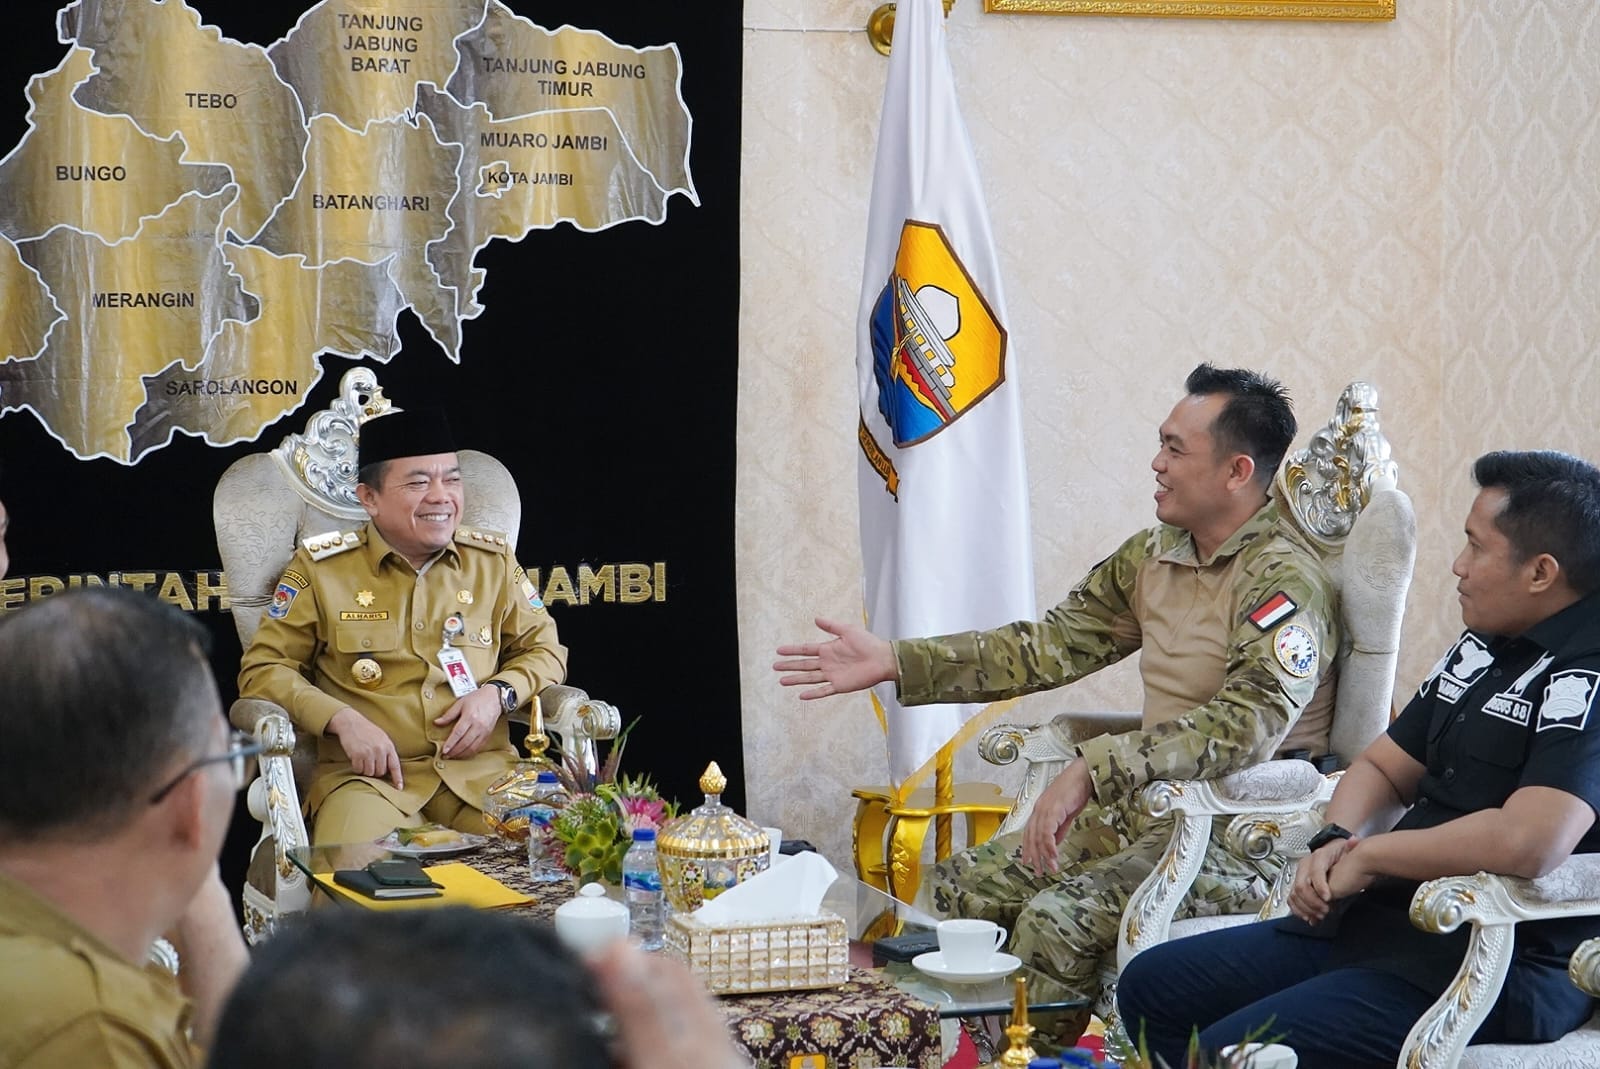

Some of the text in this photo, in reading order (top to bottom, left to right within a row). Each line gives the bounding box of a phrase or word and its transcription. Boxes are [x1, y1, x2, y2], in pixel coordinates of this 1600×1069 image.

[338, 14, 423, 32] TANJUNG
[343, 35, 418, 53] JABUNG
[351, 57, 411, 75] BARAT
[483, 57, 646, 79] TANJUNG JABUNG
[538, 80, 593, 97] TIMUR
[185, 93, 237, 109] TEBO
[480, 132, 608, 151] MUARO JAMBI
[56, 166, 126, 182] BUNGO
[487, 171, 574, 186] KOTA JAMBI
[312, 194, 430, 211] BATANGHARI
[93, 293, 195, 308] MERANGIN
[165, 379, 297, 396] SAROLANGON
